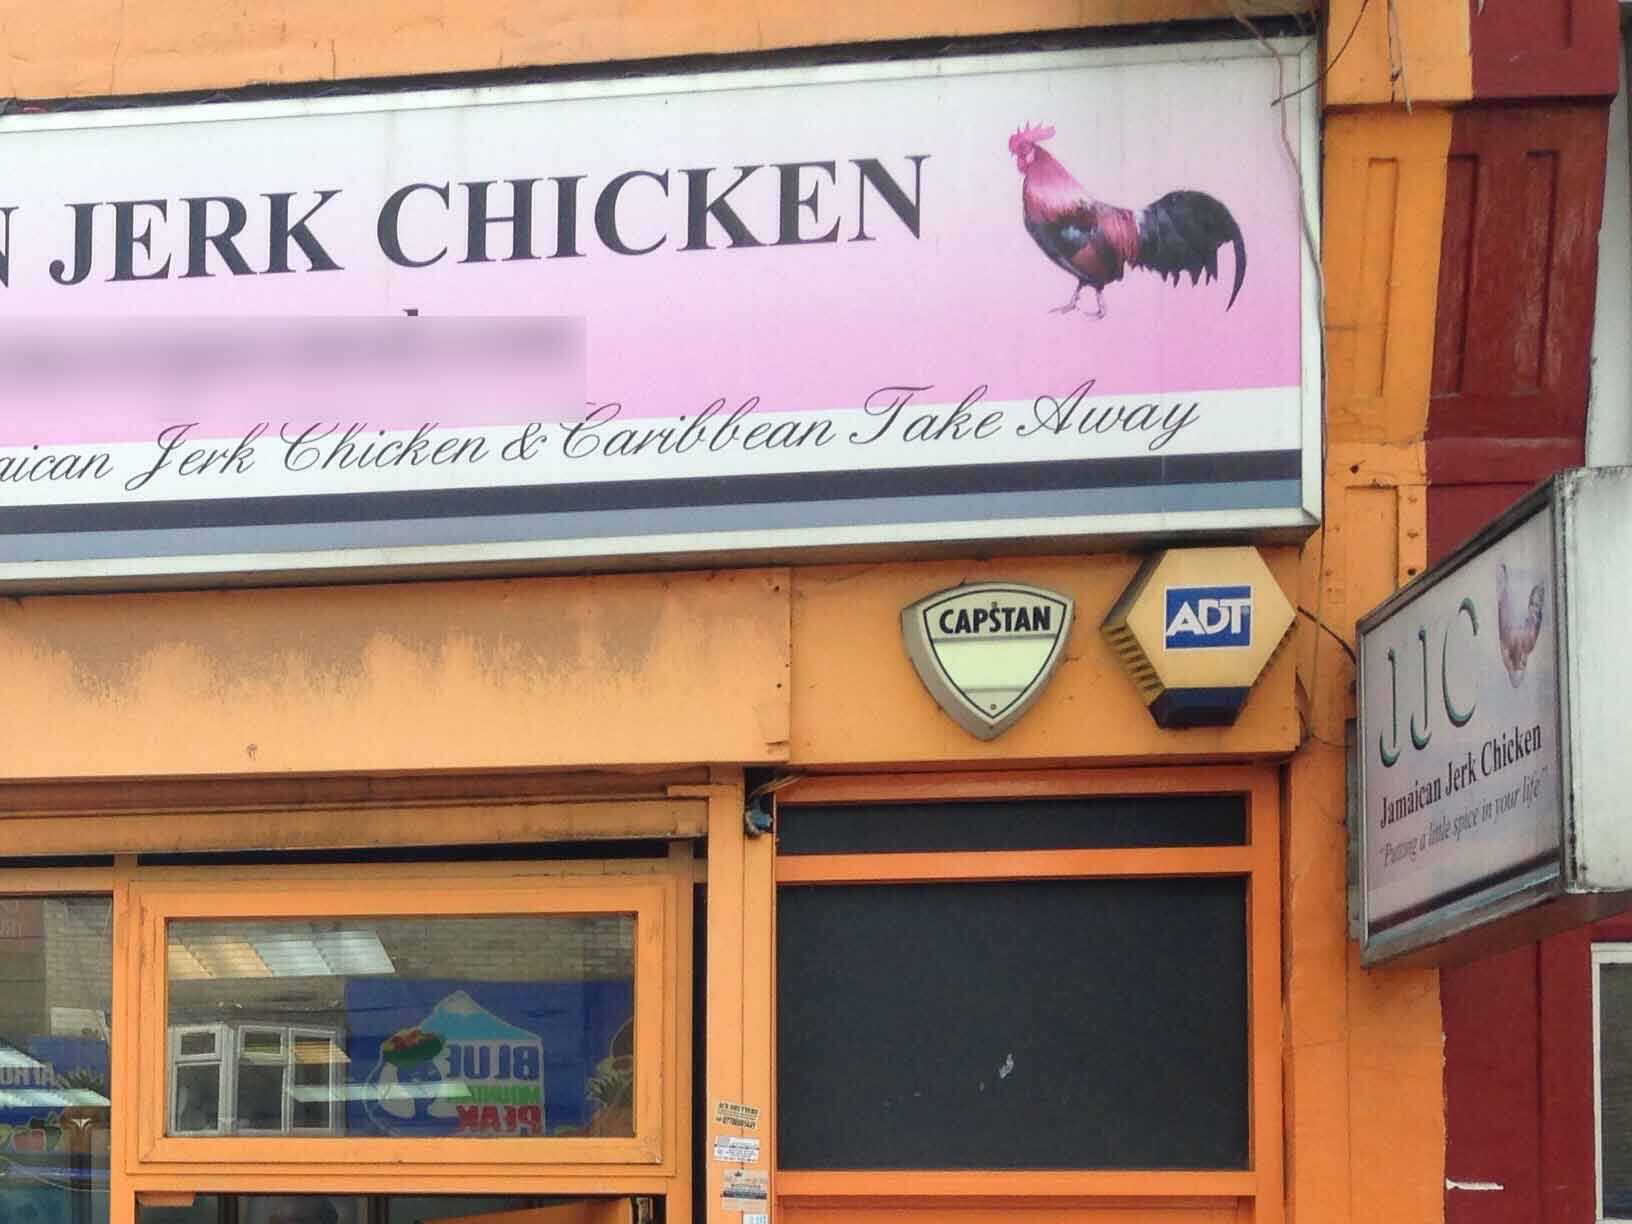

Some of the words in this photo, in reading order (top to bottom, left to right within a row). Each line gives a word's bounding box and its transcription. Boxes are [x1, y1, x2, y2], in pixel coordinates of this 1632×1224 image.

[48, 188, 345, 286] JERK
[376, 154, 932, 269] CHICKEN
[124, 421, 270, 493] Jerk
[279, 421, 490, 472] Chicken
[501, 422, 548, 462] &
[561, 396, 835, 461] Caribbean
[849, 384, 1004, 446] Take
[1015, 379, 1200, 452] Away
[939, 603, 1051, 634] CAPSTAN
[1165, 598, 1251, 637] ADT
[1378, 595, 1481, 768] JJC
[1380, 780, 1442, 829] Jamaican
[1445, 752, 1478, 796] Jerk
[1481, 724, 1542, 777] Chicken
